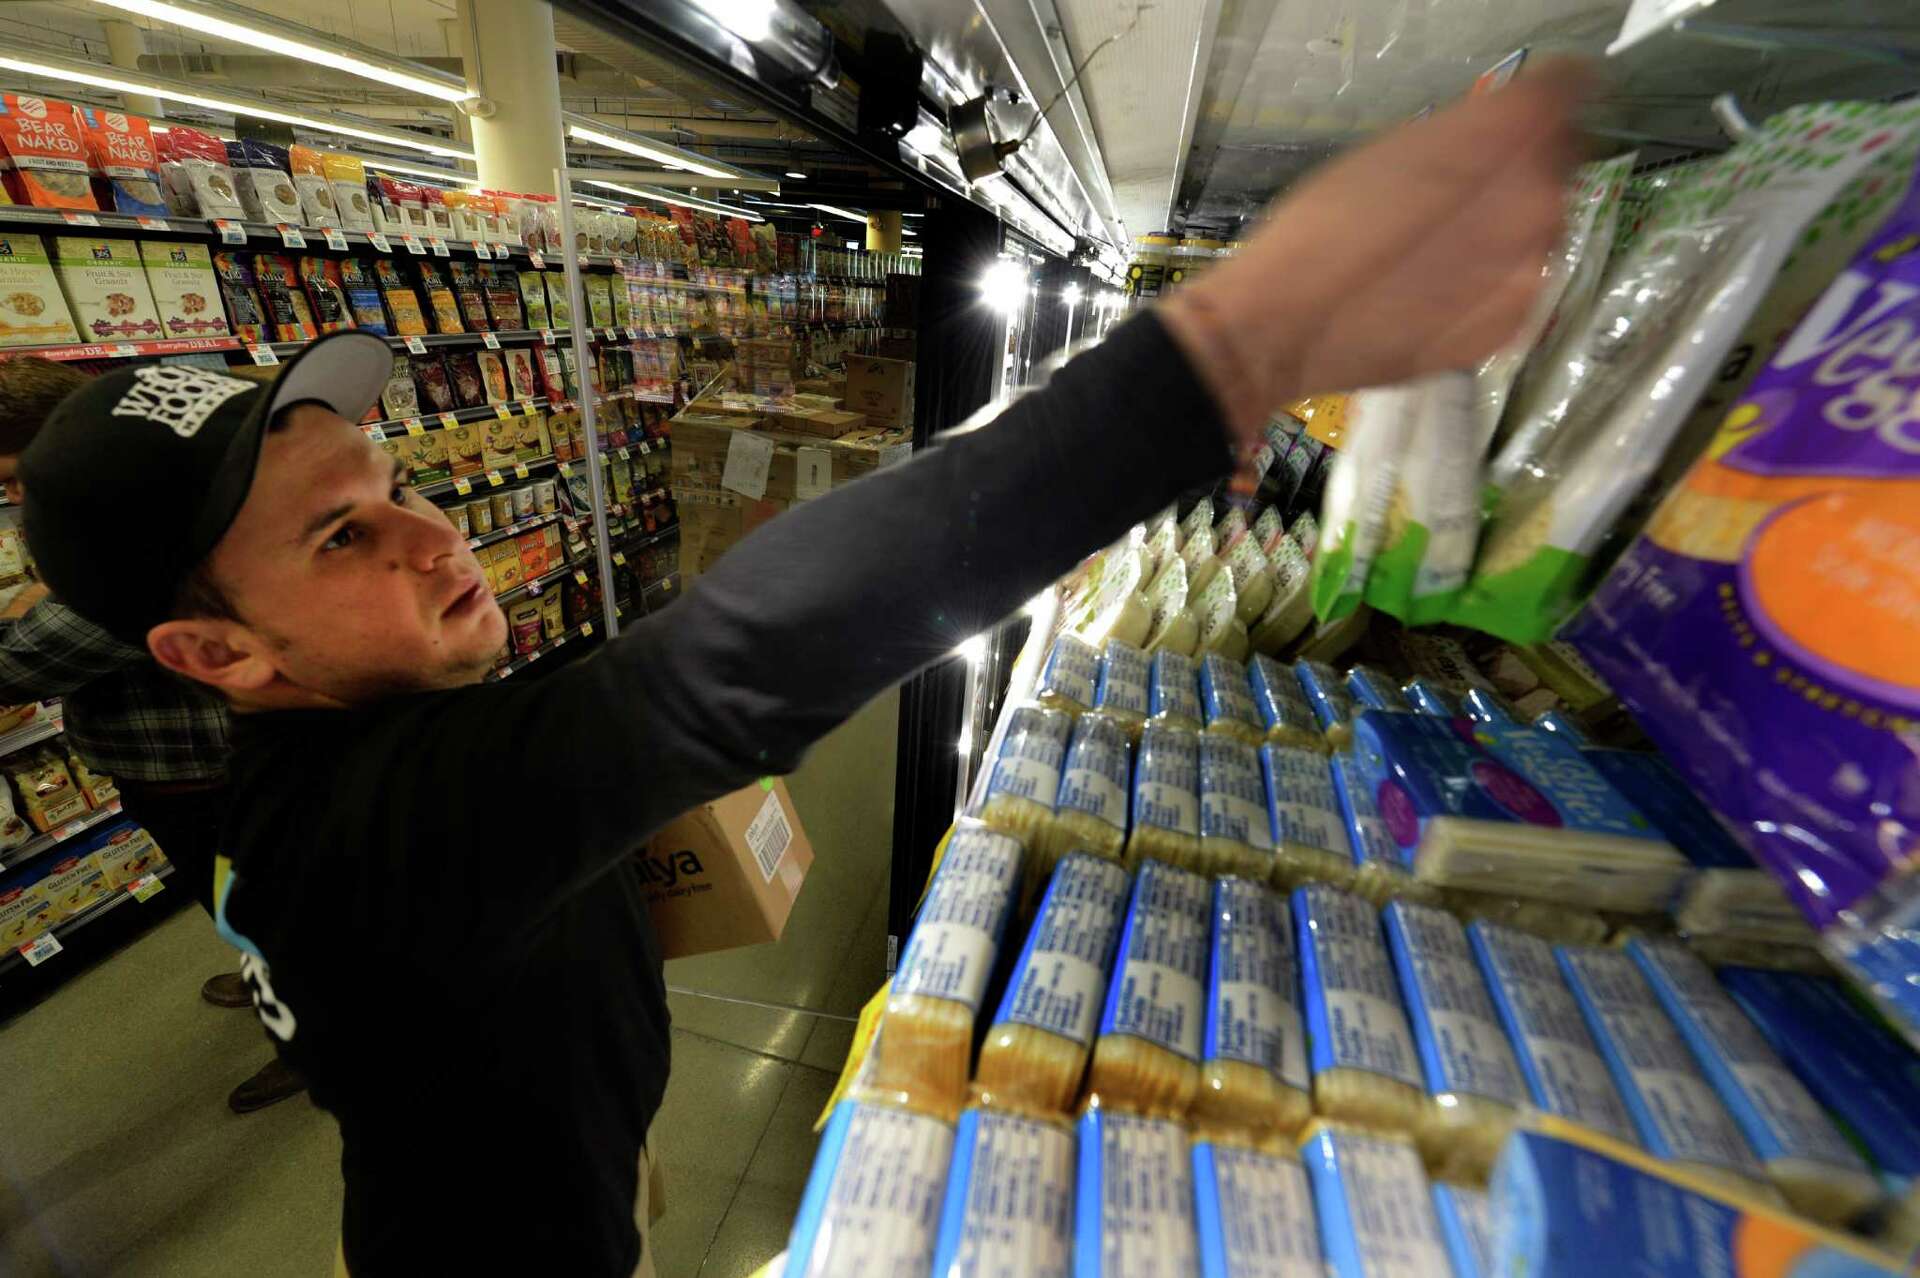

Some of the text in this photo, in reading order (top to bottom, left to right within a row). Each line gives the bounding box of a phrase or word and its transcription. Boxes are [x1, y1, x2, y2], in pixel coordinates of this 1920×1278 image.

[16, 117, 68, 137] BEAR
[16, 133, 79, 153] NAKED
[105, 131, 146, 148] BEAR
[190, 338, 221, 349] DEAL
[102, 841, 129, 860] GLUTEN
[47, 870, 77, 890] GLUTEN
